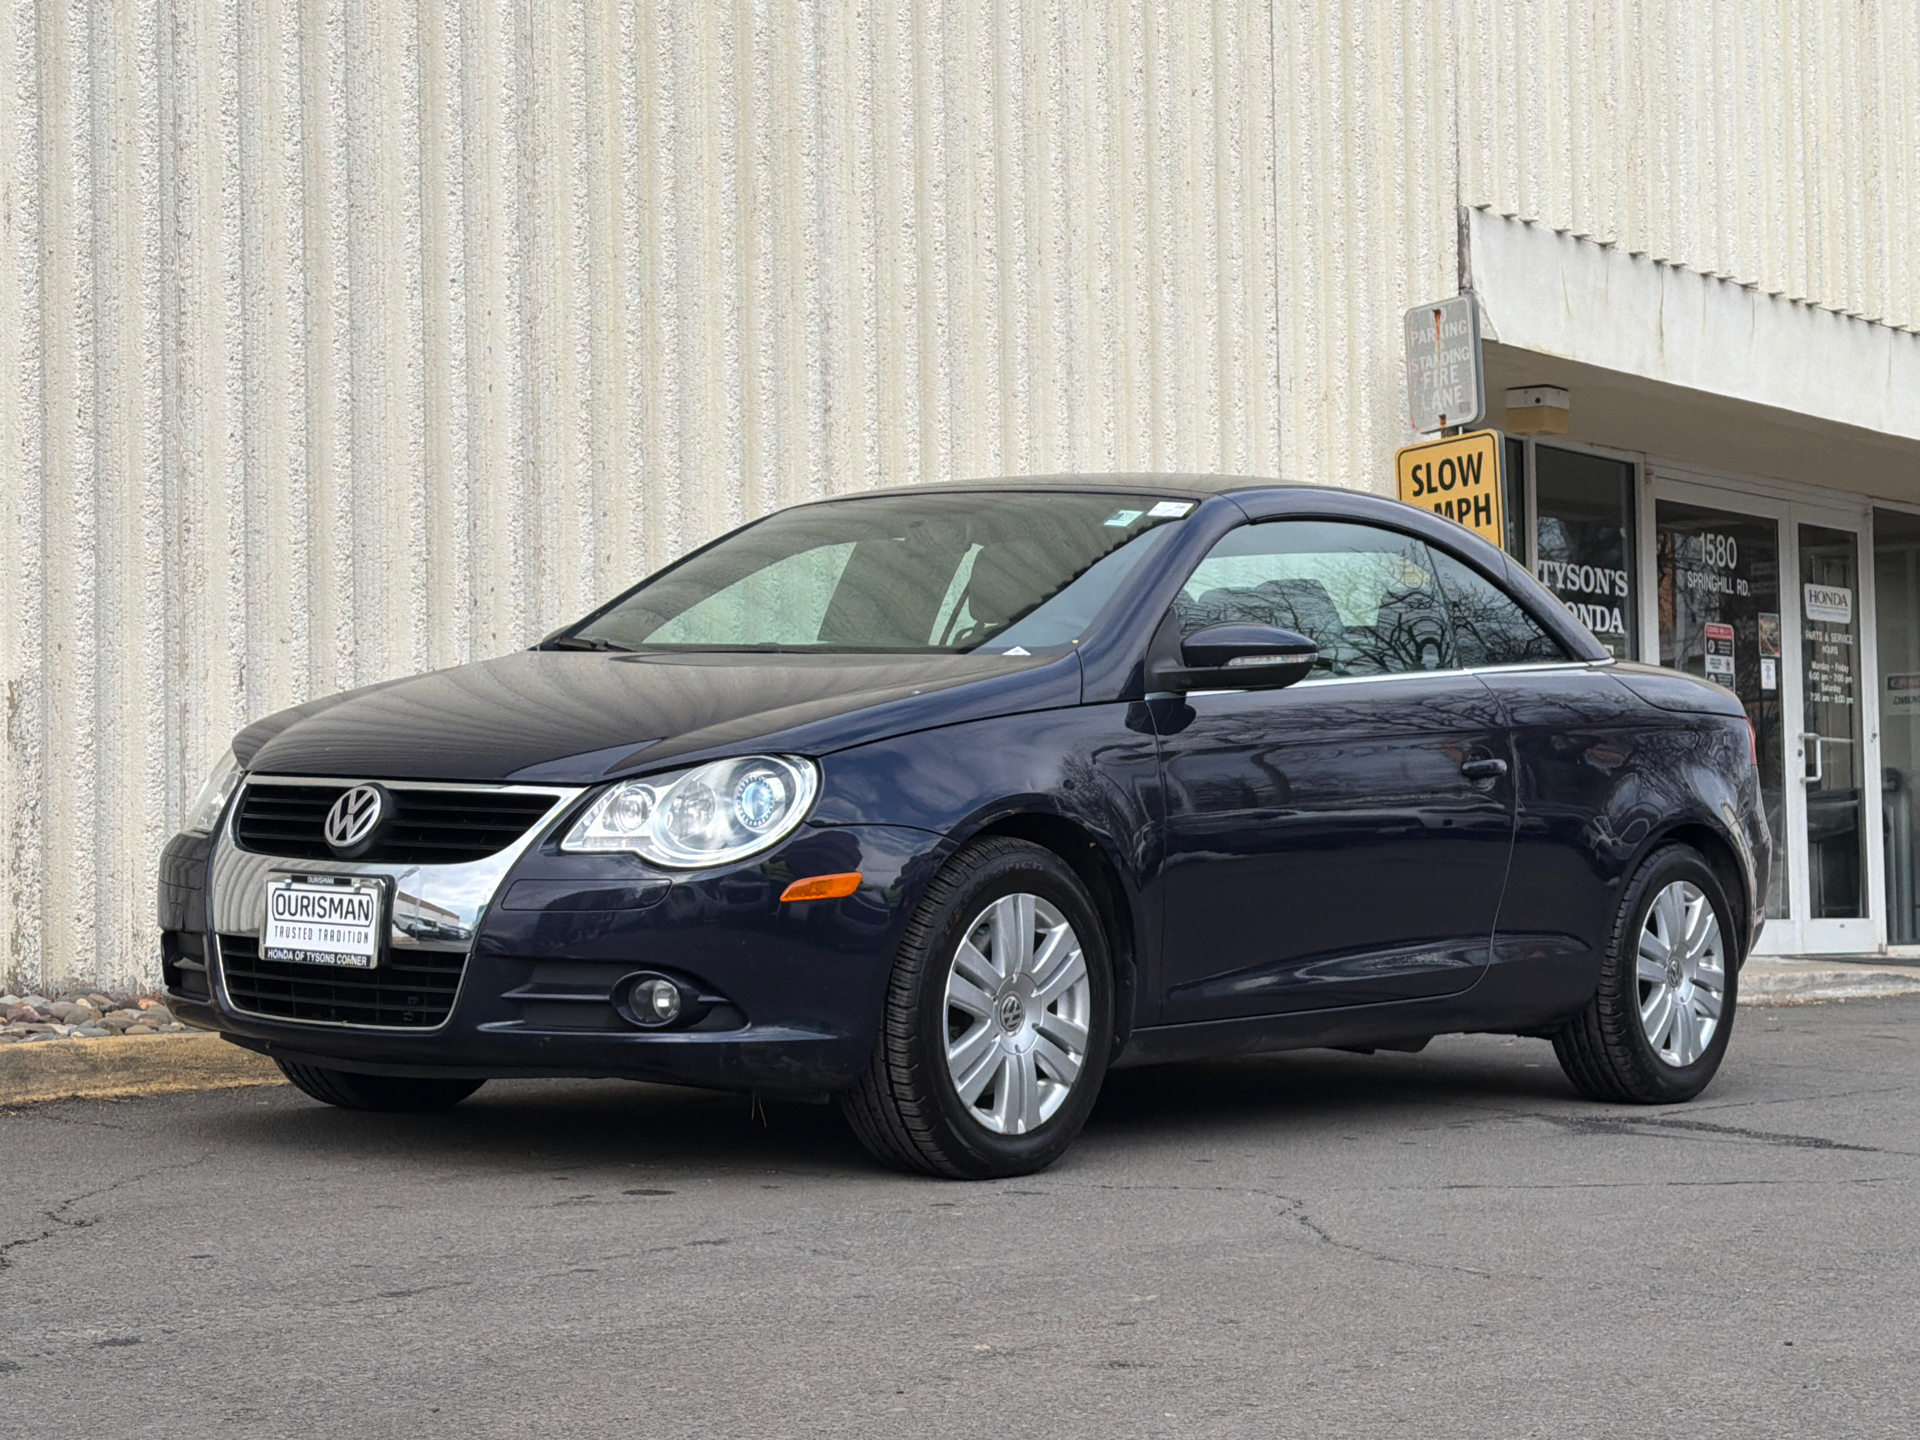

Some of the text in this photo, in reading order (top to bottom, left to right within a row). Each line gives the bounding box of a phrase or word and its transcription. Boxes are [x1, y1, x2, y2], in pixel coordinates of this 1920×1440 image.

[1410, 319, 1467, 347] PARKING
[1410, 346, 1470, 373] STANDING
[1423, 364, 1460, 390] FIRE
[1420, 385, 1463, 412] LANE
[1411, 451, 1483, 497] SLOW
[1699, 531, 1737, 570] 1580
[1538, 559, 1629, 597] TYSON'S
[1687, 570, 1751, 597] SPRINGHILL RD.
[1809, 589, 1848, 607] HONDA
[1564, 601, 1625, 634] NDA
[1805, 630, 1823, 641] PARTS
[1830, 632, 1854, 644] SERVICE
[1822, 646, 1838, 654] HOURS
[307, 876, 334, 885] OURISMAN
[275, 893, 370, 921] OURISMAN
[274, 925, 369, 944] TRUSTED TRADITION
[267, 948, 367, 967] HONDA OF TYSONS CORNER
